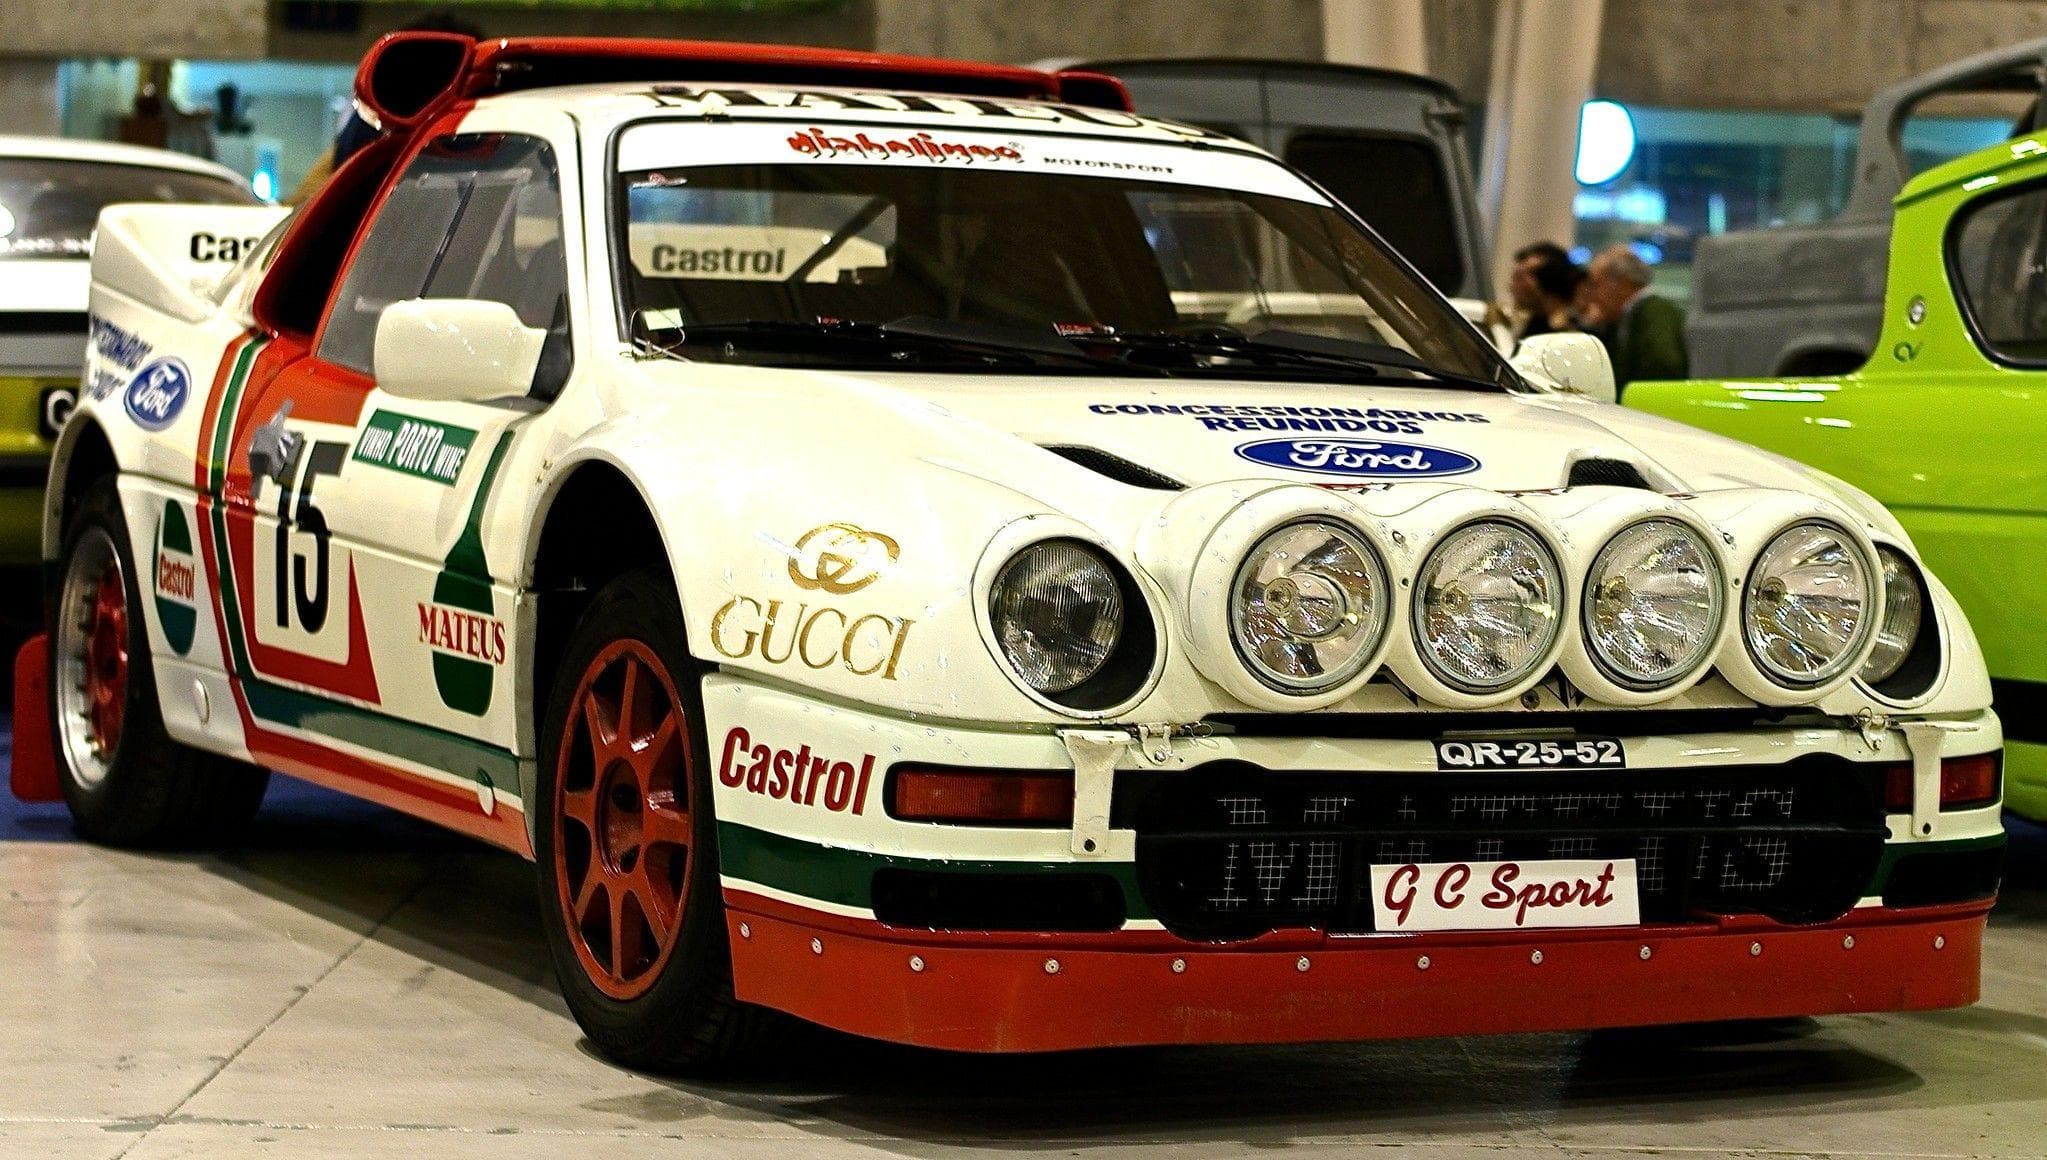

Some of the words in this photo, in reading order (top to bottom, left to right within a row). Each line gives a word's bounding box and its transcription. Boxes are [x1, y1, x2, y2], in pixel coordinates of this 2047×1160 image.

[1043, 156, 1175, 175] MOTORSPORT
[652, 244, 786, 274] Castrol
[387, 419, 445, 474] PORTO
[433, 443, 466, 480] WINE
[1195, 416, 1424, 435] REUNIDOS
[1290, 440, 1432, 471] Ford
[272, 432, 350, 634] 15
[159, 552, 195, 602] Castrol
[417, 602, 506, 666] MATEUS
[710, 595, 917, 682] GUCCI
[718, 726, 877, 817] Castrol
[1439, 741, 1622, 768] QR-25-52
[1383, 863, 1421, 927] G
[1433, 863, 1471, 909] C
[1481, 862, 1615, 926] Sport
